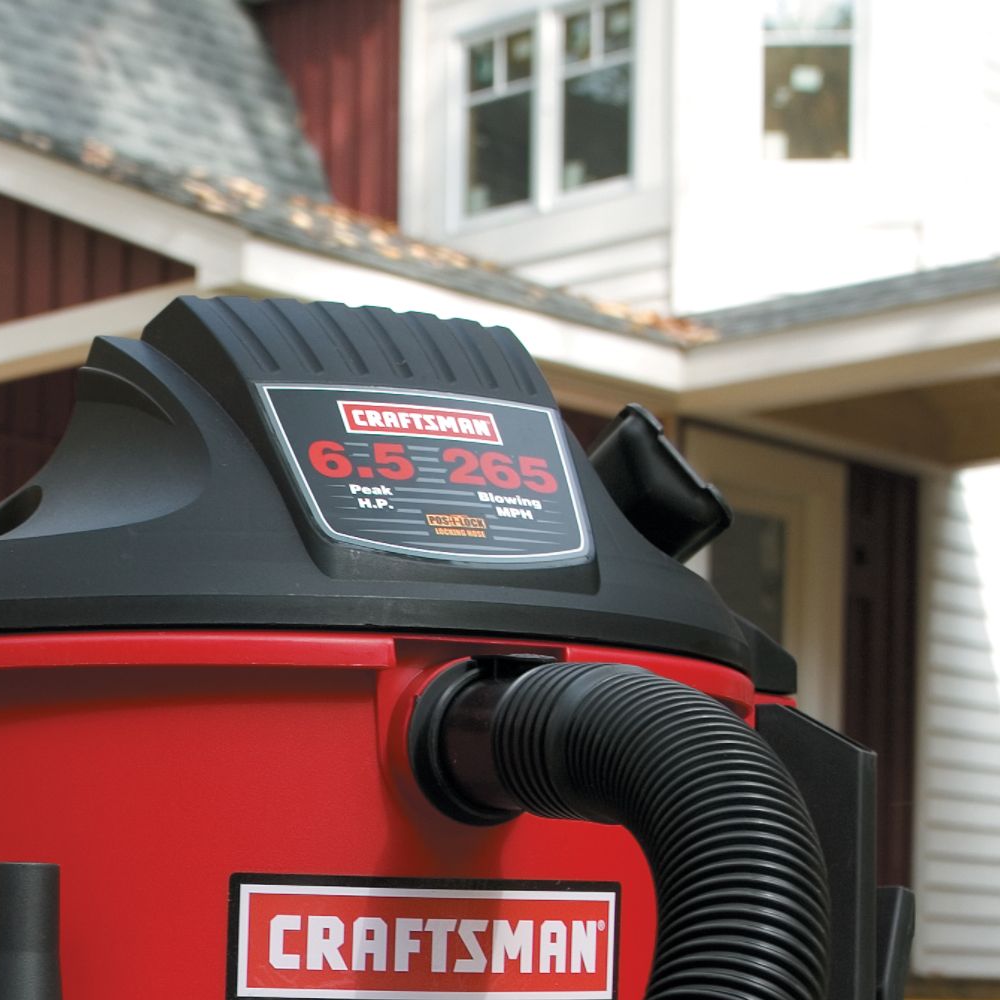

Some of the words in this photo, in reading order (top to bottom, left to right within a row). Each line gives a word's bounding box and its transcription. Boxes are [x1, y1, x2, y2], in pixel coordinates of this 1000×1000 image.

[351, 409, 491, 437] CRAFTSMAN
[308, 440, 415, 481] 6.5
[443, 447, 558, 493] 265
[350, 484, 393, 497] Peak
[477, 491, 542, 510] Blowing
[358, 498, 394, 510] H.P.
[496, 506, 534, 521] MPH
[269, 914, 597, 974] CRAFTSMAN
